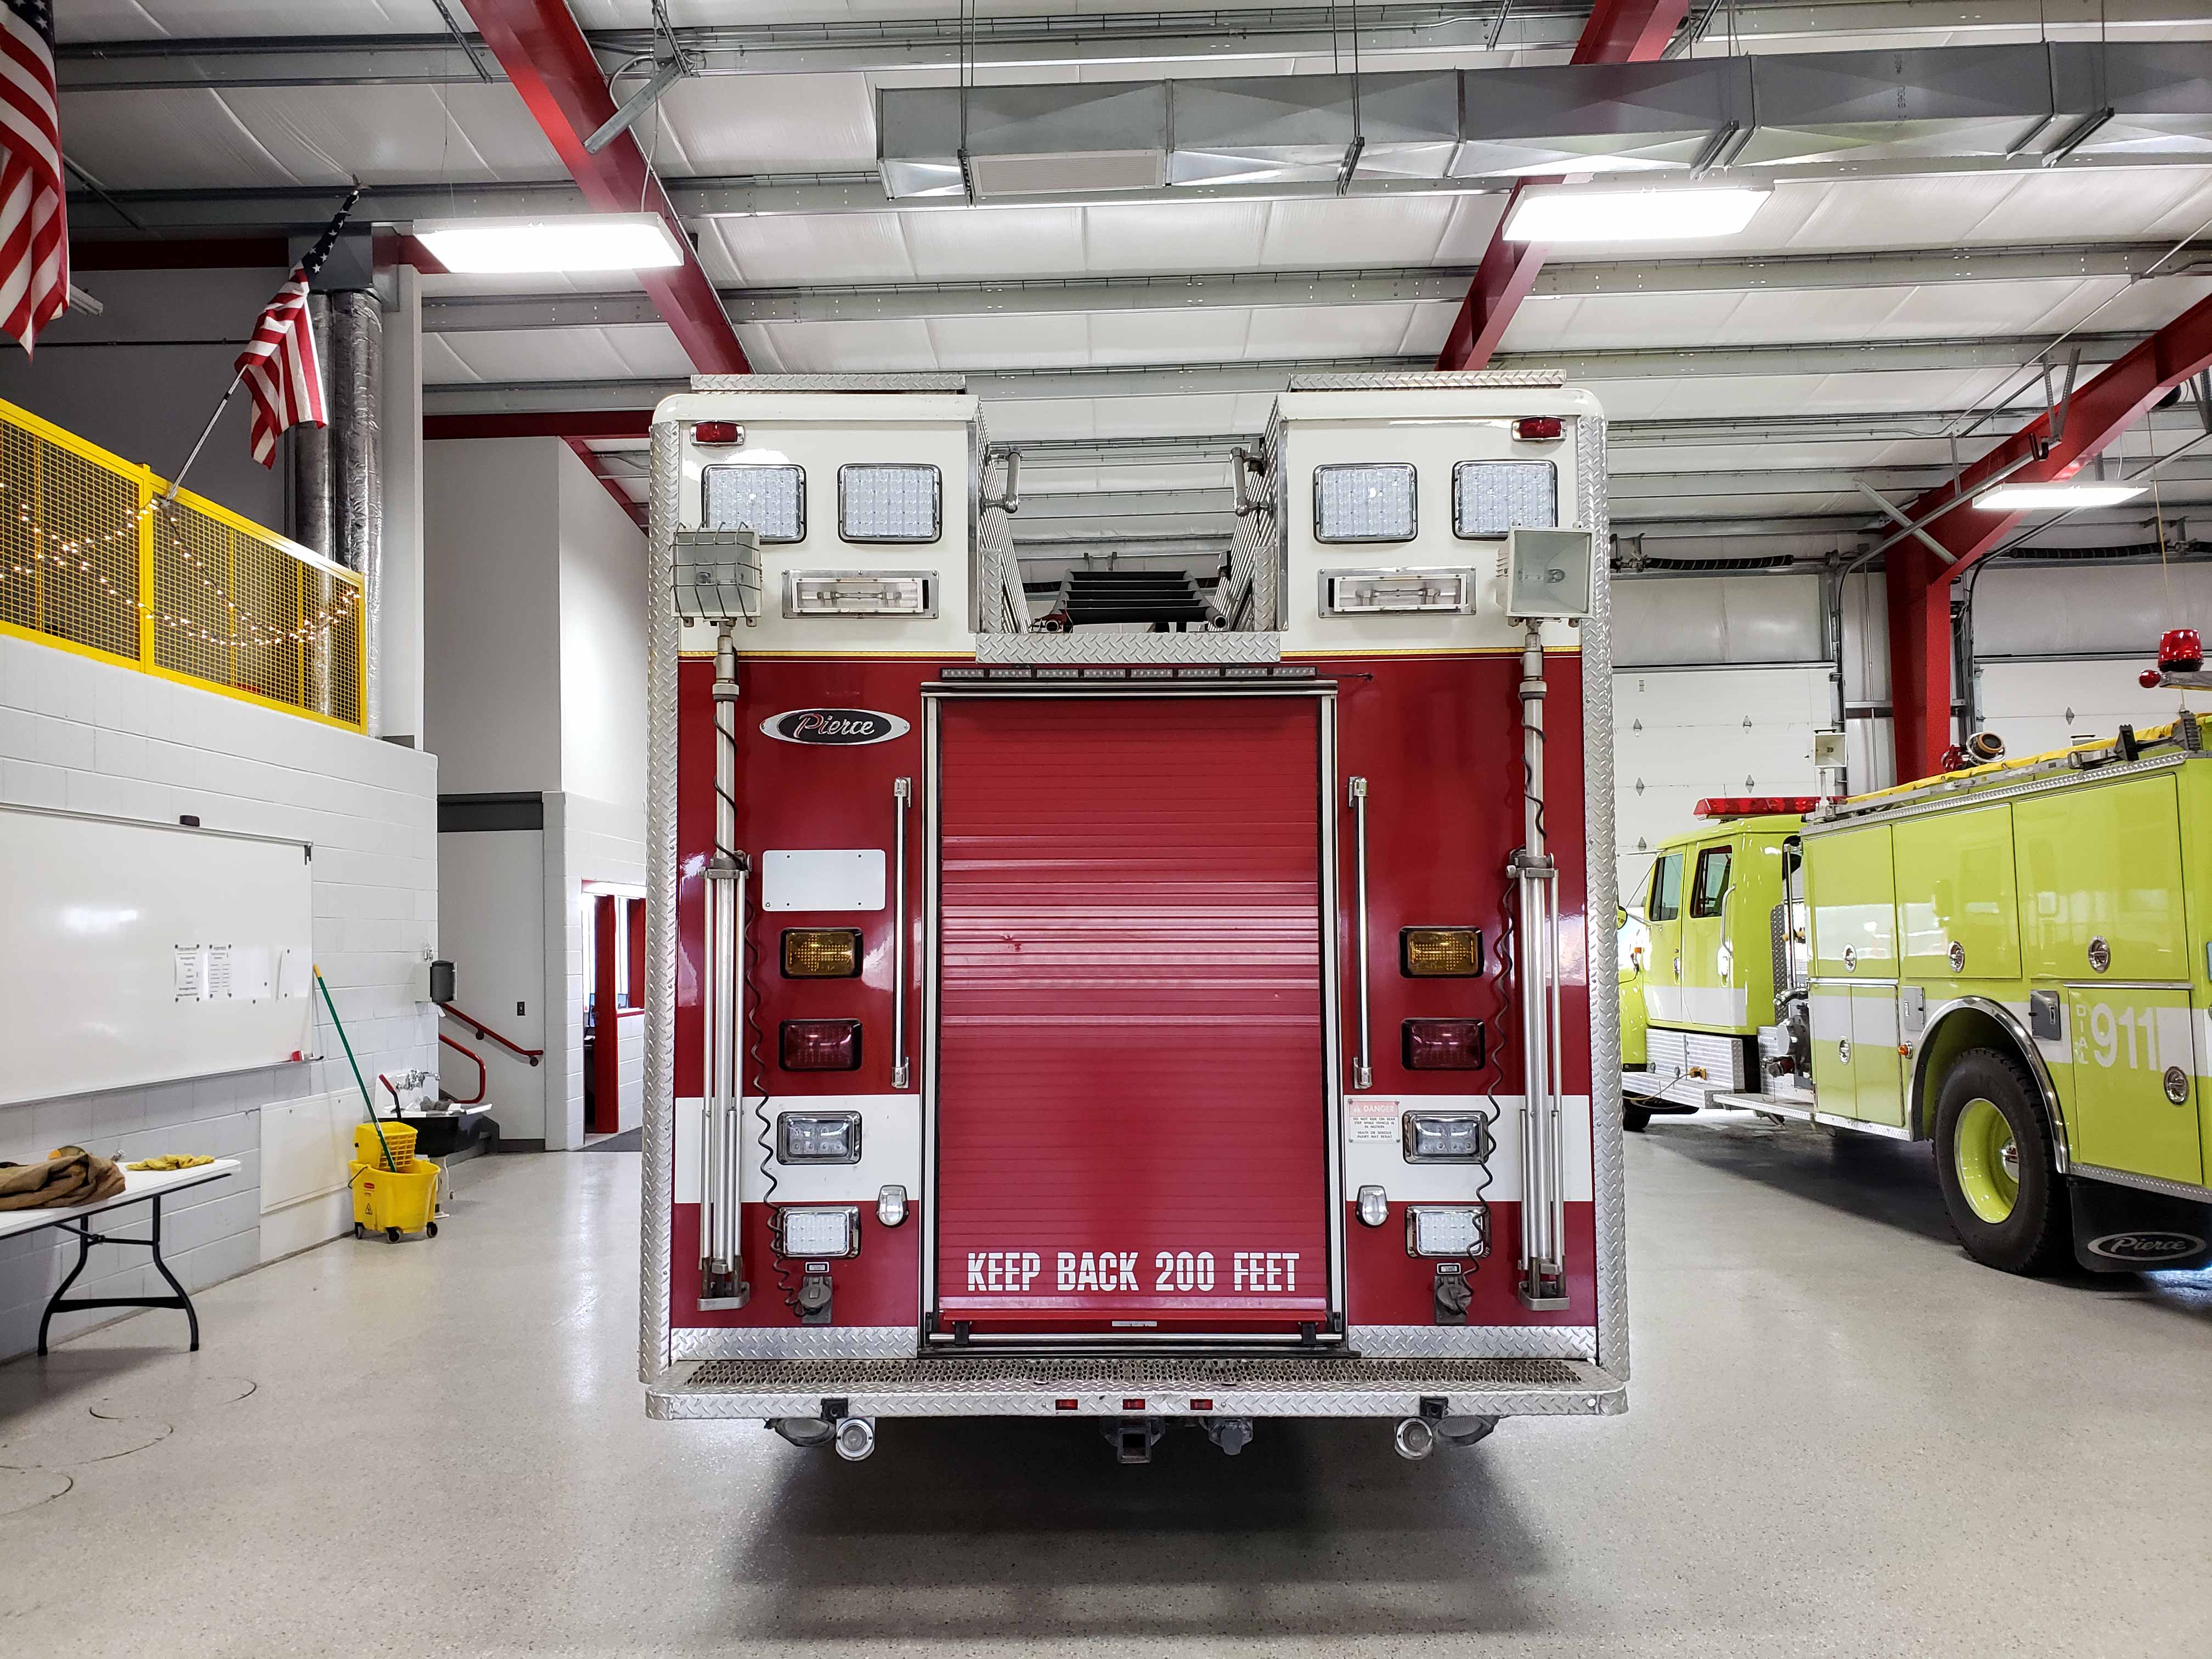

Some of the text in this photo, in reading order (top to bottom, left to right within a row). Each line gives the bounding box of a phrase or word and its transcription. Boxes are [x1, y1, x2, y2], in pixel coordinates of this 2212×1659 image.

[793, 713, 875, 738] Pierce
[2091, 1002, 2158, 1071] 911
[2111, 1237, 2186, 1252] Pierce
[968, 1251, 1300, 1291] KEEP BACK 200 FEET
